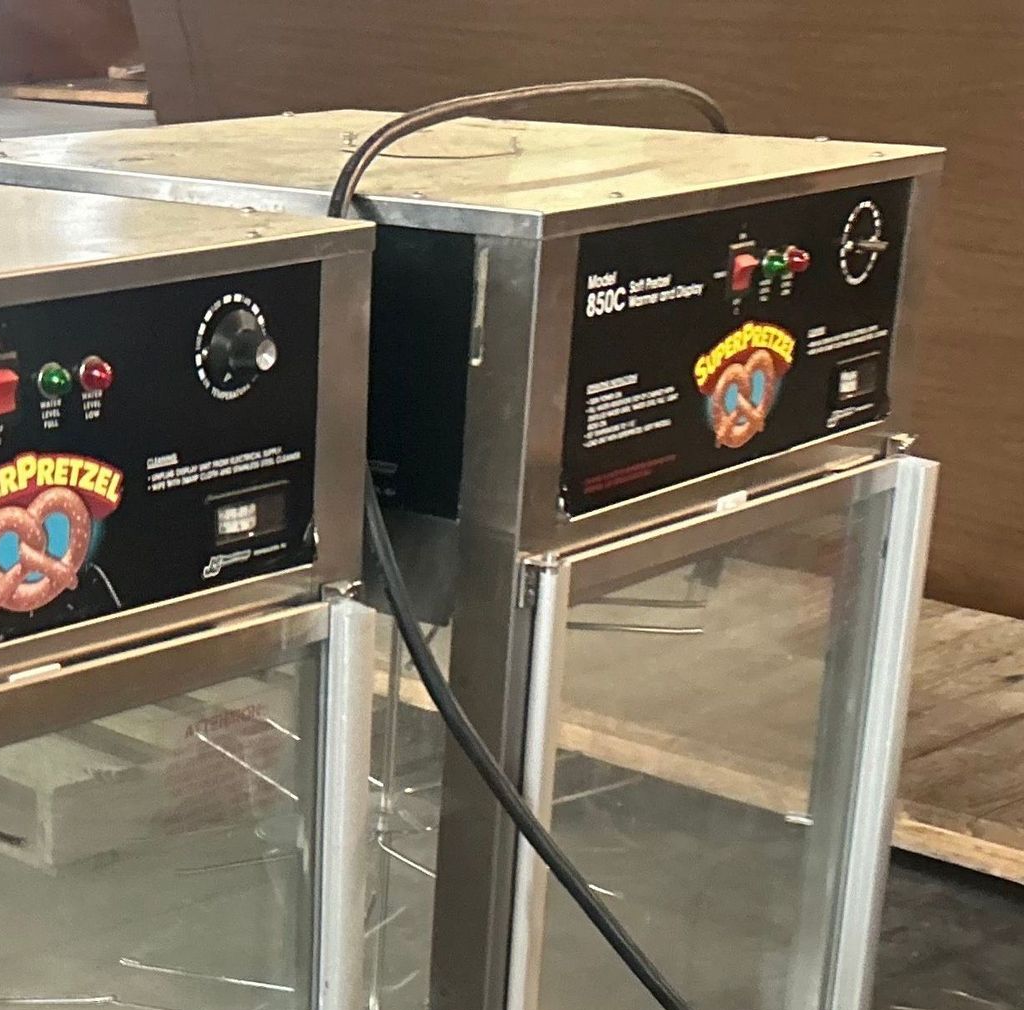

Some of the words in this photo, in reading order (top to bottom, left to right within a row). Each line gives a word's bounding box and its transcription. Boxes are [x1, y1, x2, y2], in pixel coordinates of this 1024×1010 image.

[587, 271, 618, 290] Model
[586, 286, 626, 317] 850C
[694, 322, 796, 386] SUPERPRETZEL
